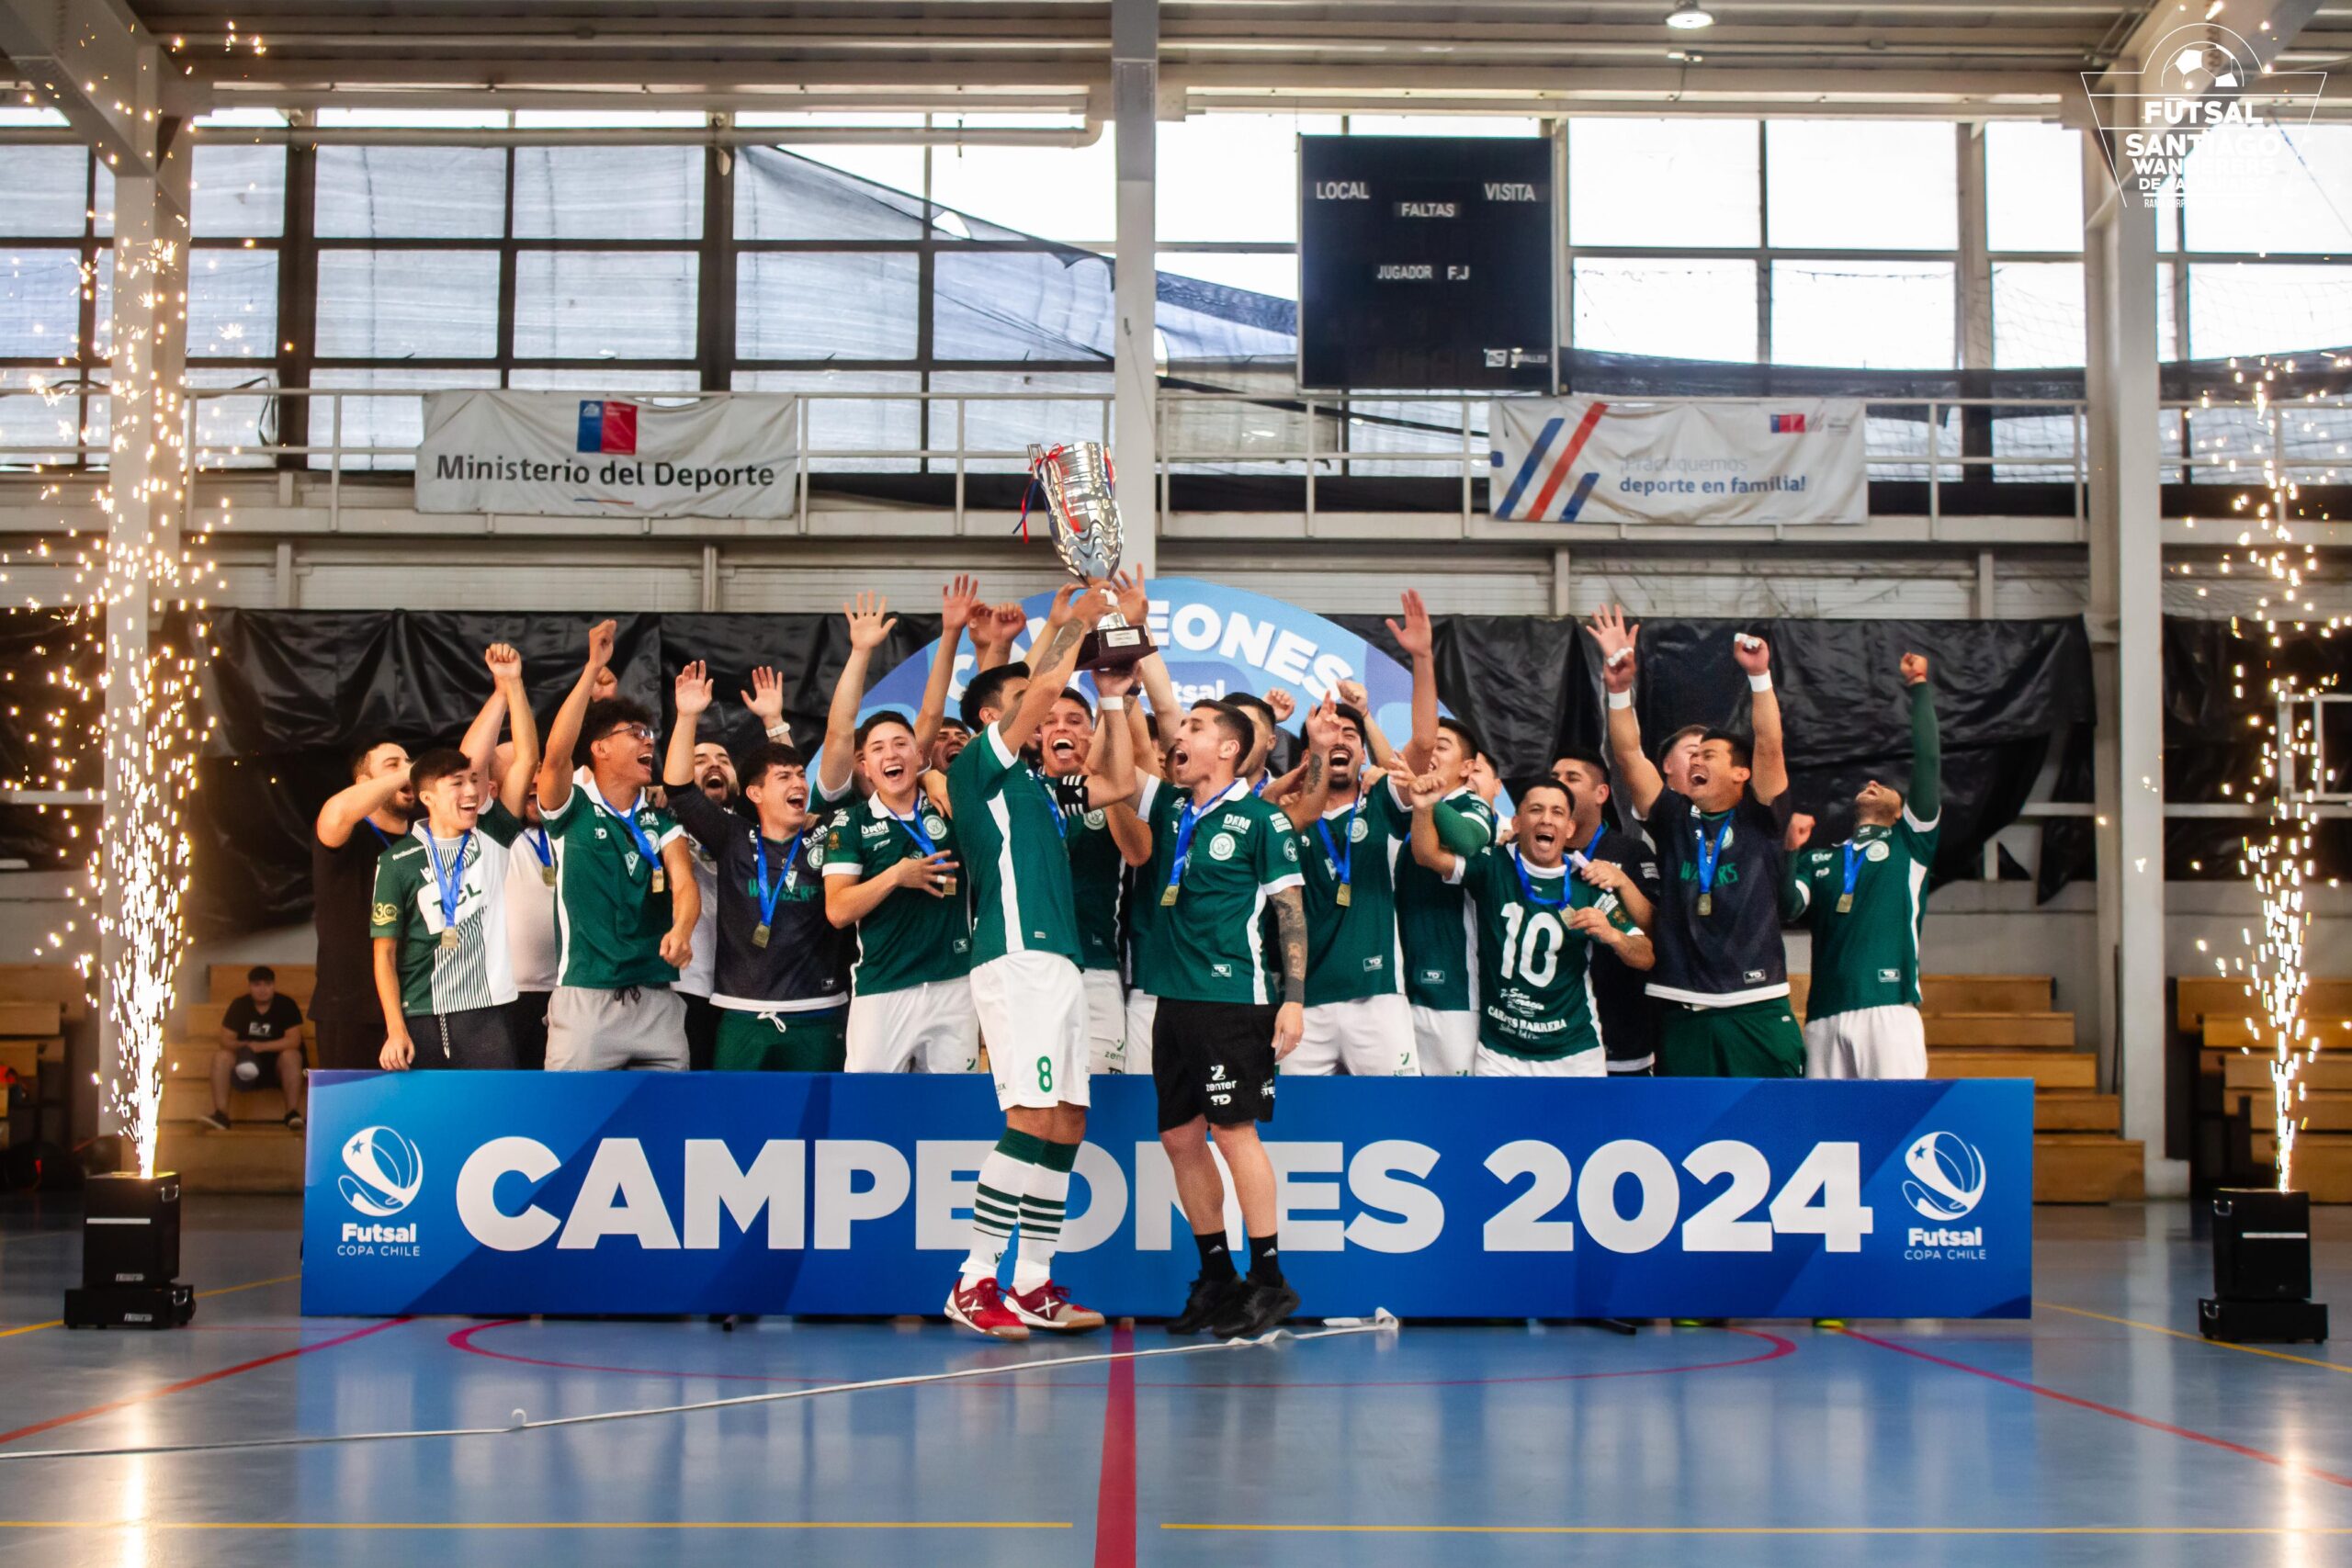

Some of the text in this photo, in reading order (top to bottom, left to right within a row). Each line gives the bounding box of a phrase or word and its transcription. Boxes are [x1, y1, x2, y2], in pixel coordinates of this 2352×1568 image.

[1316, 181, 1370, 200] LOCAL
[1484, 183, 1536, 202] VISITA
[1400, 202, 1455, 218] FALTAS
[1377, 265, 1433, 279] JUGADOR
[435, 454, 775, 492] Ministerio del Deporte
[1620, 475, 1806, 495] deporte en familia!
[1499, 901, 1564, 988] 10
[1036, 1055, 1053, 1093] 8
[1482, 1138, 1874, 1255] 2024
[341, 1222, 417, 1244] Futsal
[1907, 1226, 1984, 1247] Futsal
[336, 1245, 421, 1257] COPA CHILE
[1904, 1249, 1987, 1260] COPA CHILE
